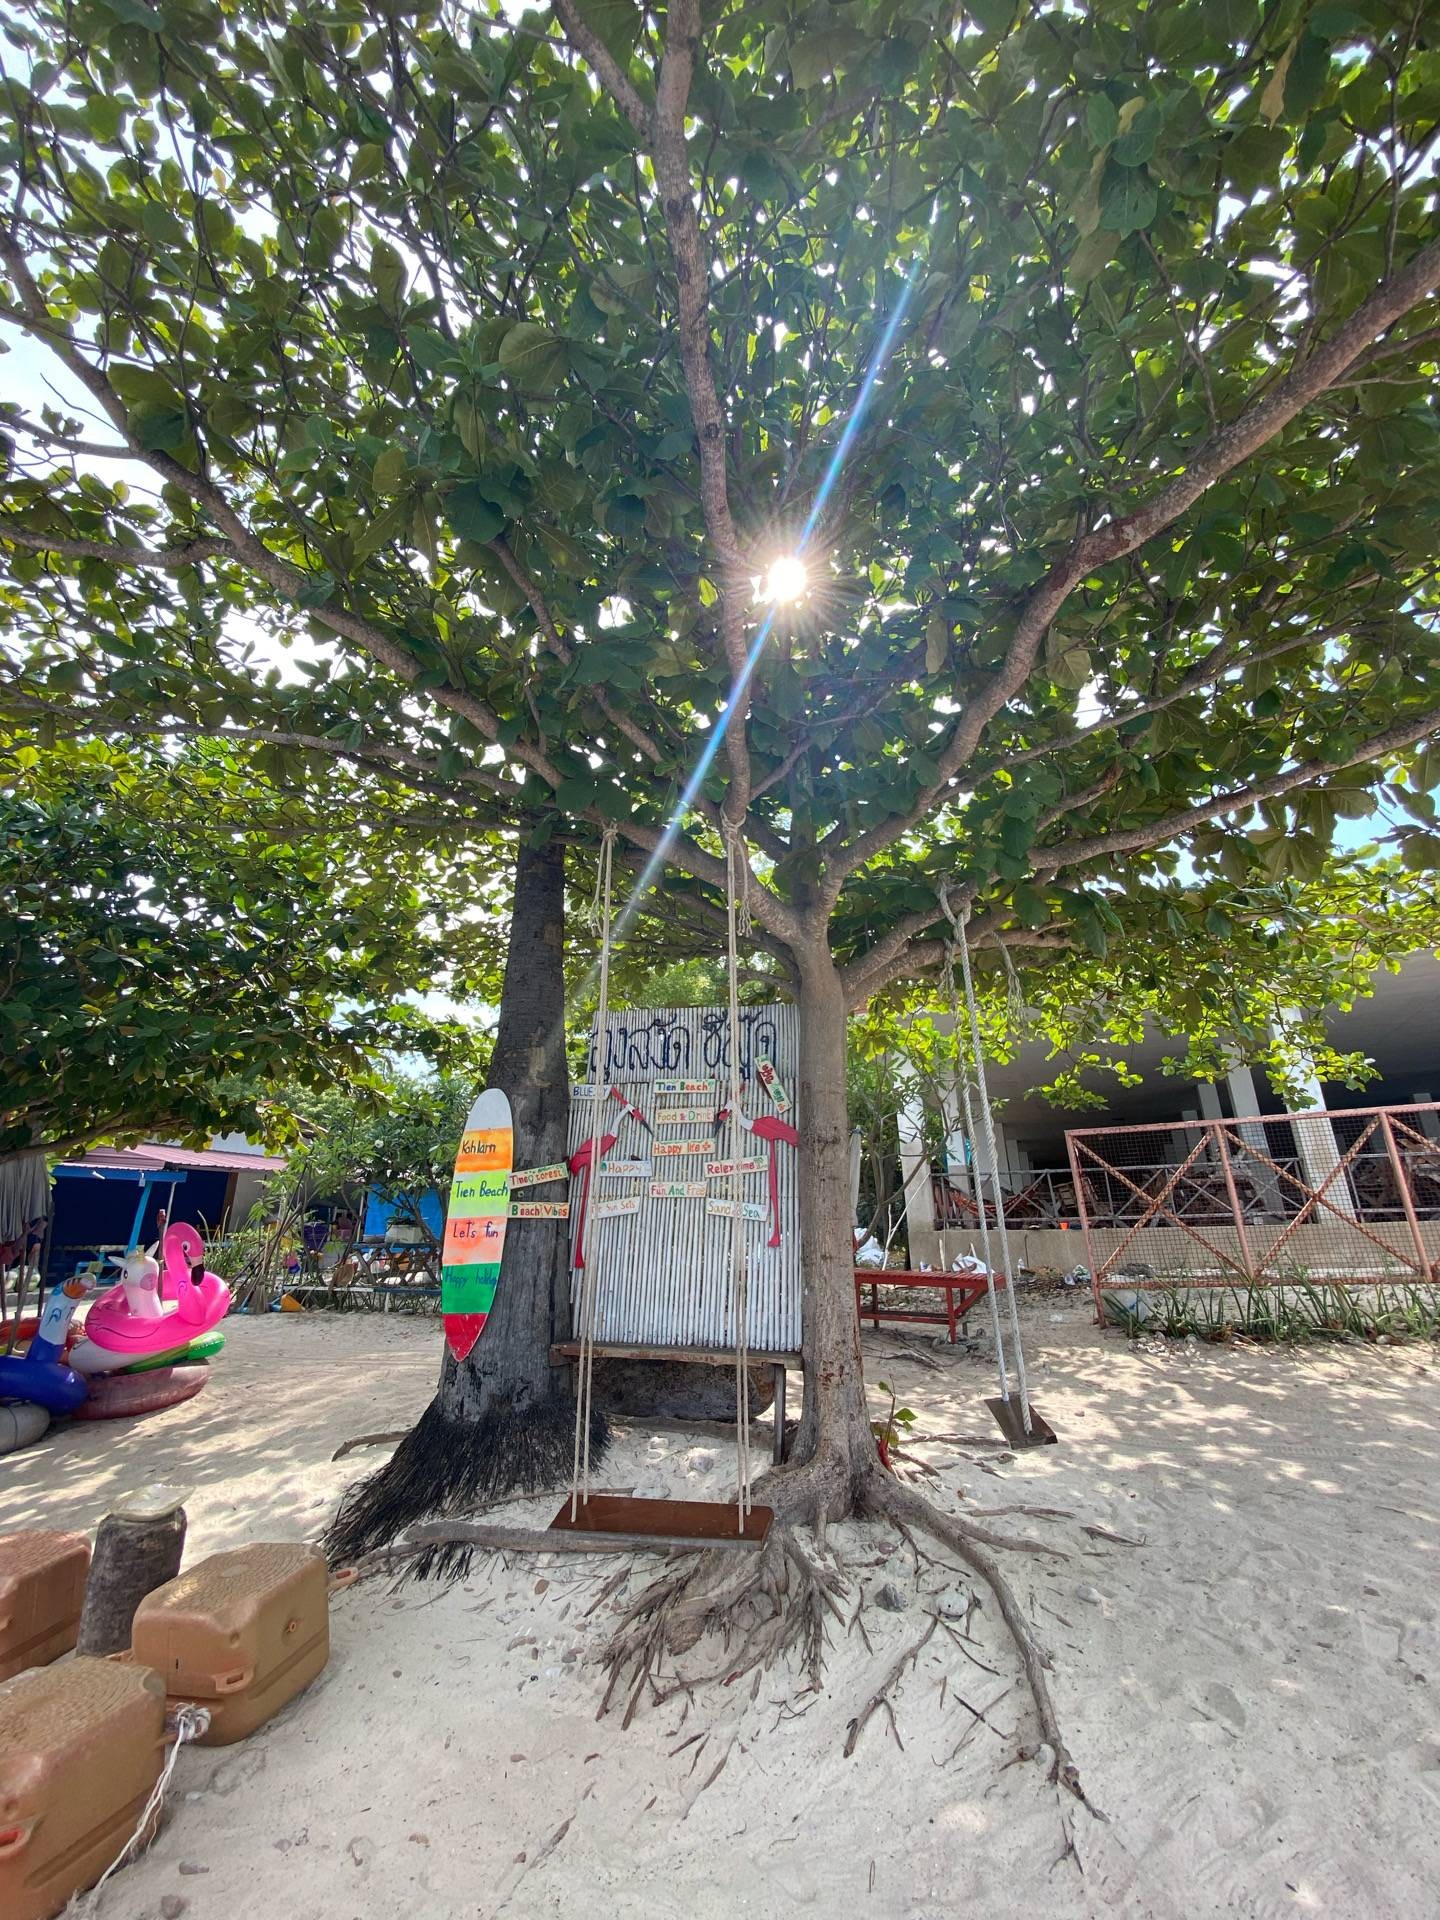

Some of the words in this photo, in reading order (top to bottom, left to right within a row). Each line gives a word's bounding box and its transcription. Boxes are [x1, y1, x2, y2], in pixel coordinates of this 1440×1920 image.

[655, 1081, 676, 1091] Tien
[679, 1081, 708, 1091] Beach
[657, 1112, 677, 1121] Food
[653, 1144, 682, 1156] Happy
[455, 1180, 475, 1198] Tien
[480, 1180, 509, 1197] Beach
[651, 1185, 666, 1195] Fun
[668, 1185, 685, 1195] And
[687, 1184, 706, 1195] Free
[512, 1204, 540, 1216] Beach
[543, 1204, 567, 1216] Vibes
[708, 1200, 731, 1215] Sand
[742, 1204, 760, 1218] Sea
[484, 1221, 498, 1238] fun
